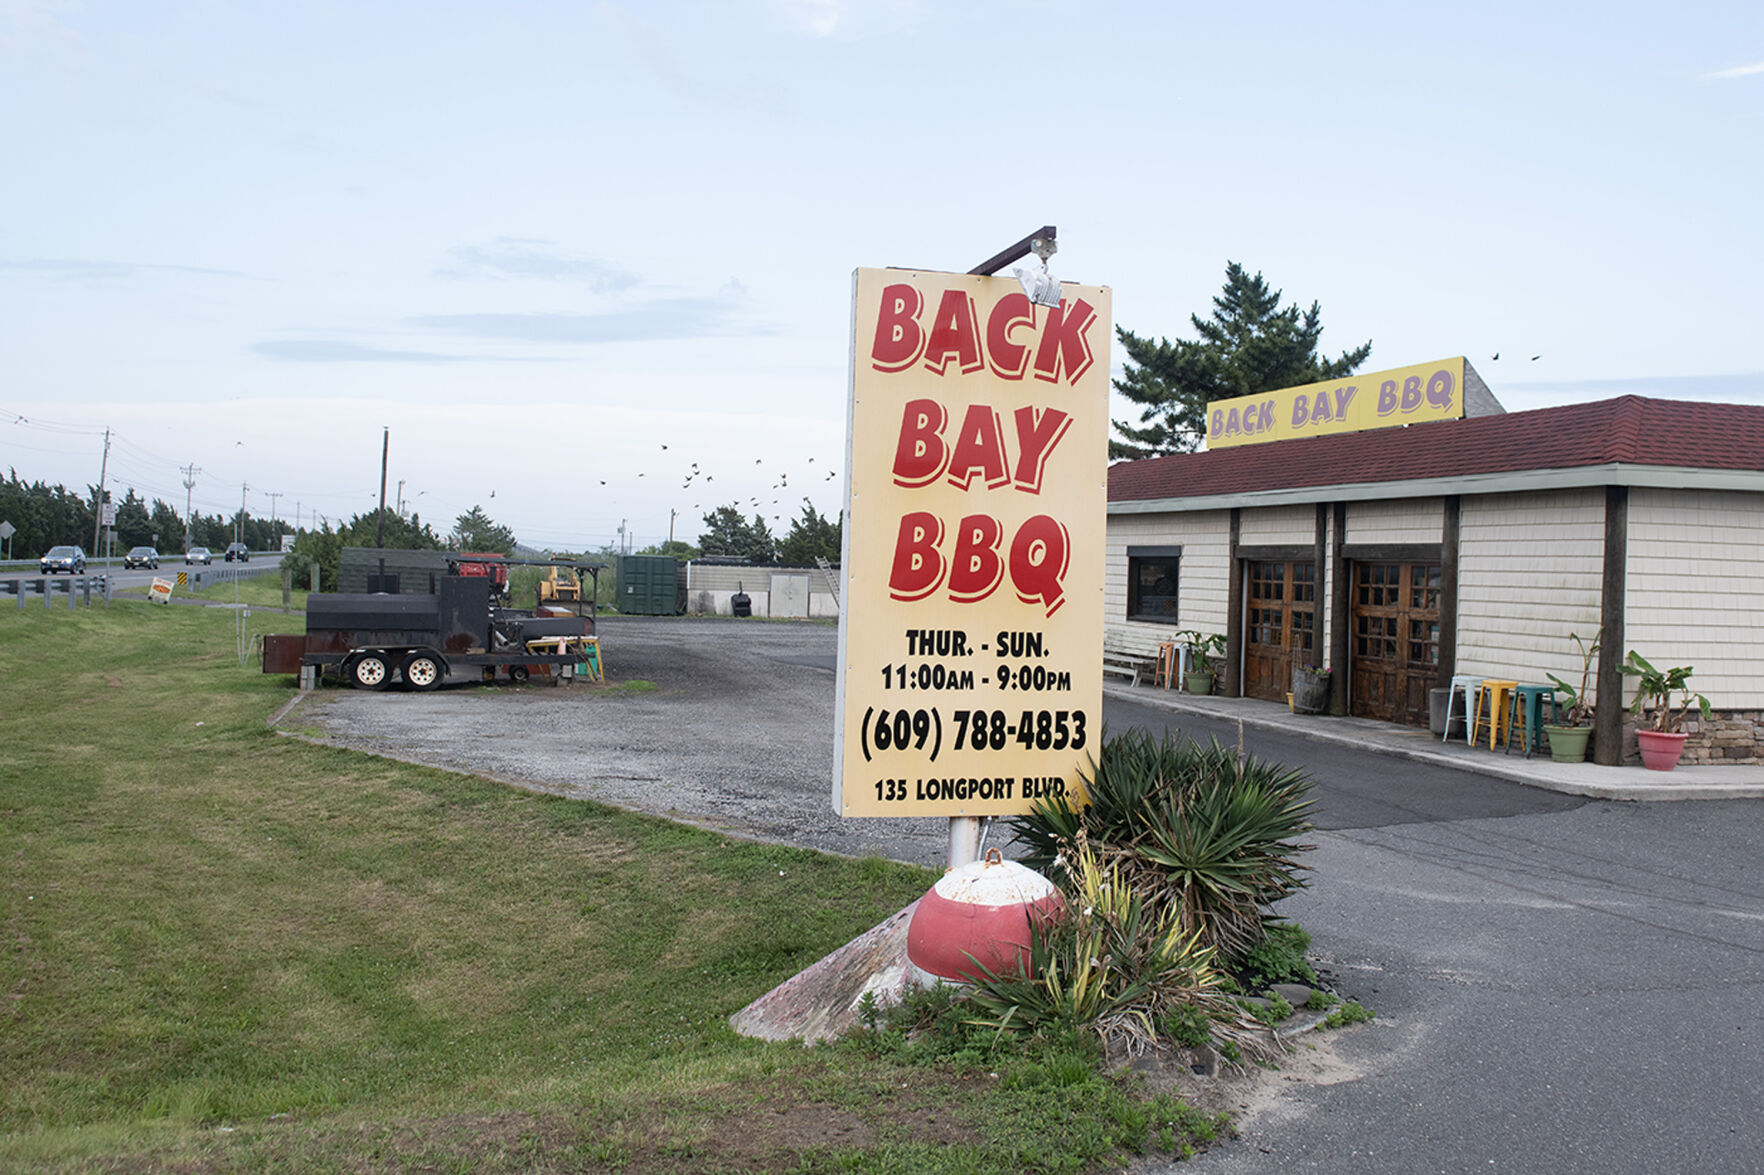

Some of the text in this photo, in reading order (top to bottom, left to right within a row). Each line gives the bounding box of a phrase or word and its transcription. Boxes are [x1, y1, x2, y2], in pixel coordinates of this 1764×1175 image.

[871, 283, 1097, 387] BACK
[1210, 369, 1456, 440] BACK BAY BBQ
[892, 398, 1074, 496] BAY
[888, 511, 1071, 619] BBQ
[906, 629, 974, 657] THUR.
[996, 631, 1050, 658] SUN.
[881, 663, 974, 691] 11:00AM
[996, 665, 1071, 692] 9:00PM
[861, 706, 1087, 763] (609) 788-4853
[874, 777, 1070, 802] 135 LONGPORT BLVD.
